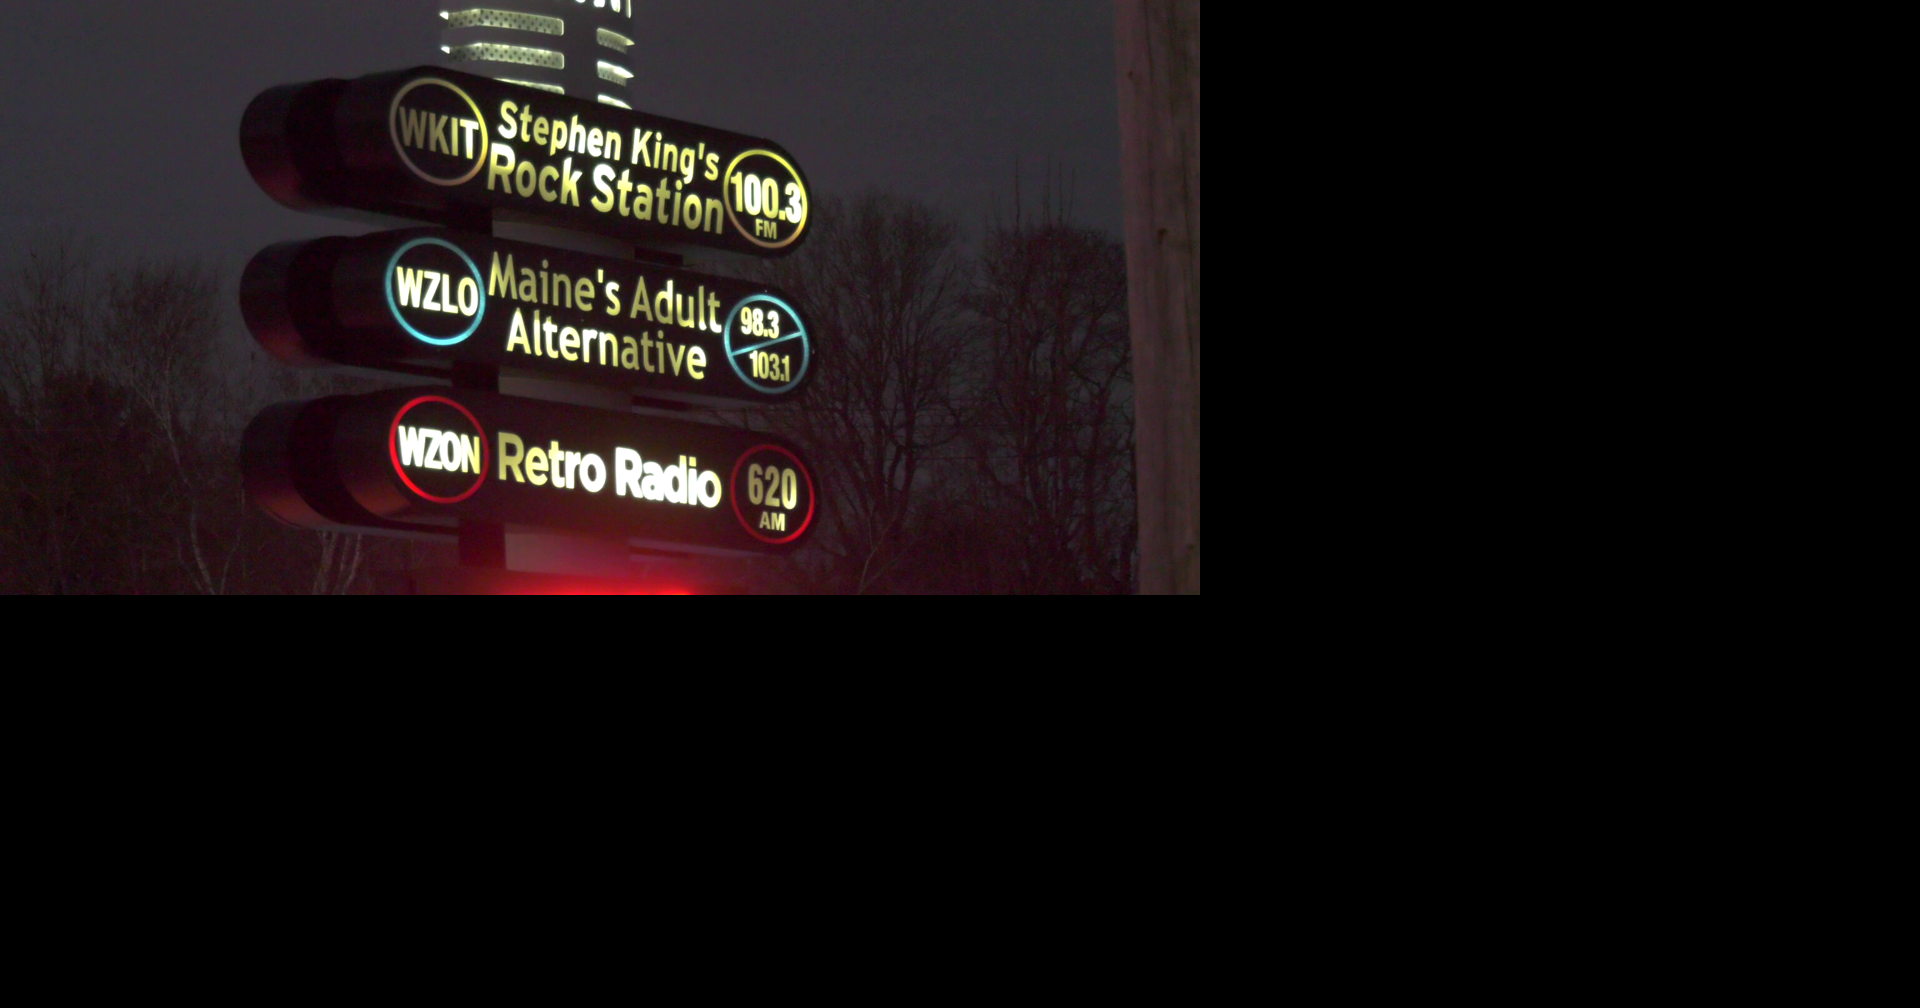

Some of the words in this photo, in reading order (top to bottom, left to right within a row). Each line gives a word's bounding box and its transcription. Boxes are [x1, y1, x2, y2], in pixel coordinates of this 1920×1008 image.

[399, 107, 479, 158] WKIT
[498, 100, 622, 161] Stephen
[631, 126, 720, 184] King's
[486, 142, 582, 206] Rock
[591, 164, 724, 234] Station
[731, 172, 801, 223] 100.3
[754, 218, 777, 239] FM
[397, 267, 478, 316] WZLO
[489, 252, 620, 314] Maine's
[631, 276, 722, 333] Adult
[507, 307, 706, 379] Alternative
[741, 307, 779, 339] 98.3
[749, 350, 790, 382] 103.1
[399, 426, 480, 474] WZON
[498, 431, 606, 492] Retro
[614, 446, 722, 508] Radio
[748, 464, 796, 509] 620
[759, 511, 785, 532] AM
